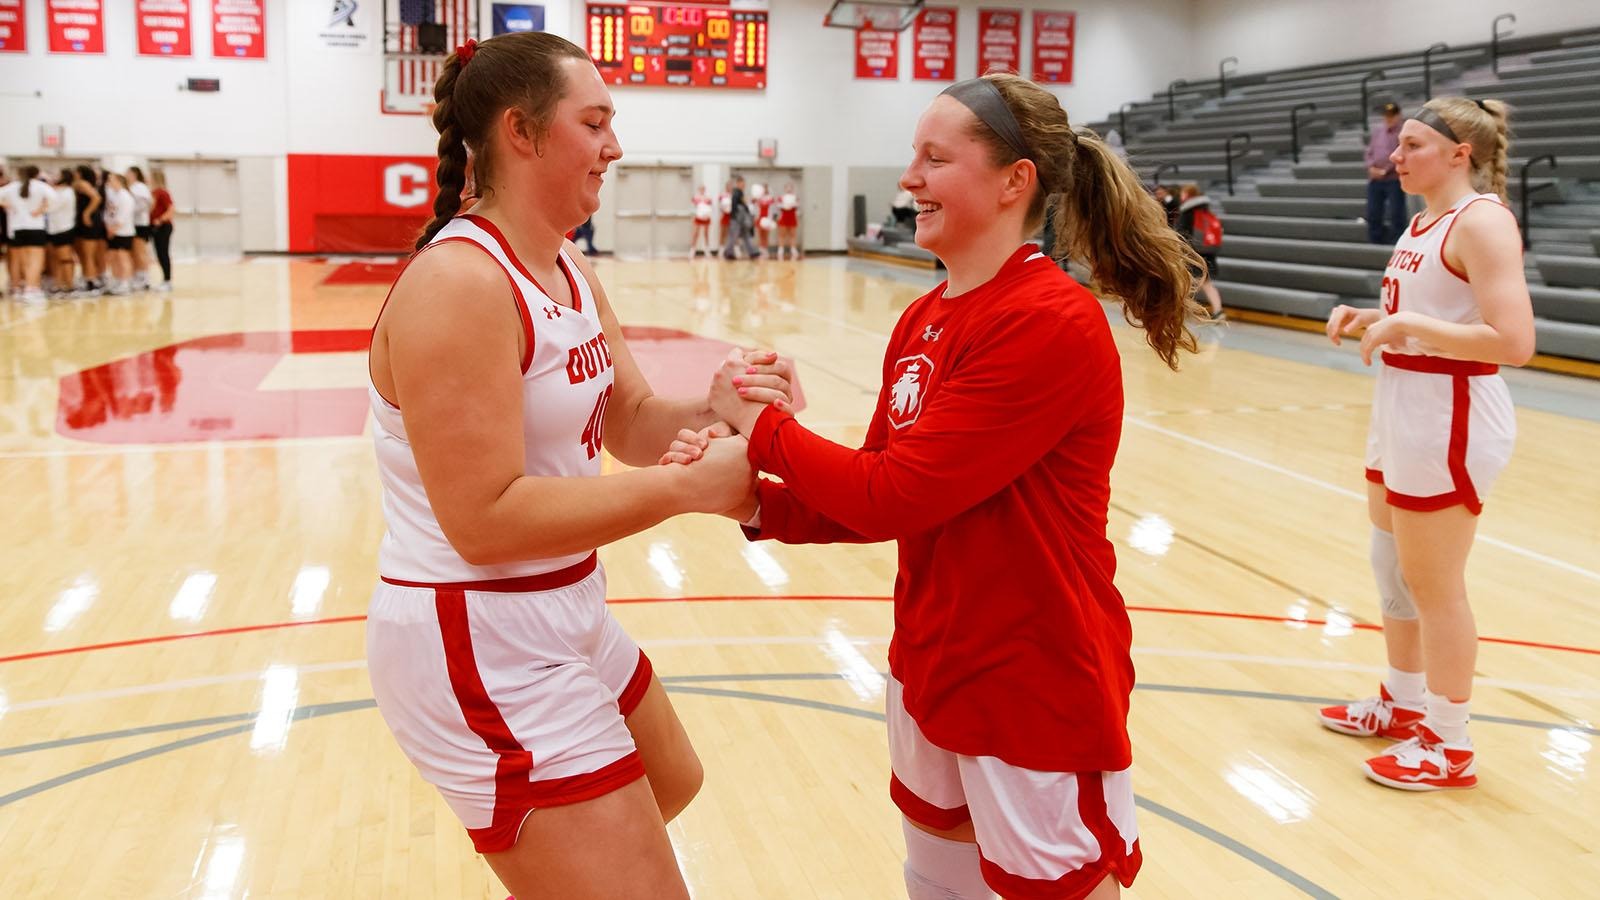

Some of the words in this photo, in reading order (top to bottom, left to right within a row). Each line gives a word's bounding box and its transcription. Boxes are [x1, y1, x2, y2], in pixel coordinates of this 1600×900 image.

[384, 162, 428, 208] C
[1386, 249, 1424, 273] UTCH
[566, 331, 613, 385] DUTC
[580, 383, 613, 461] 40
